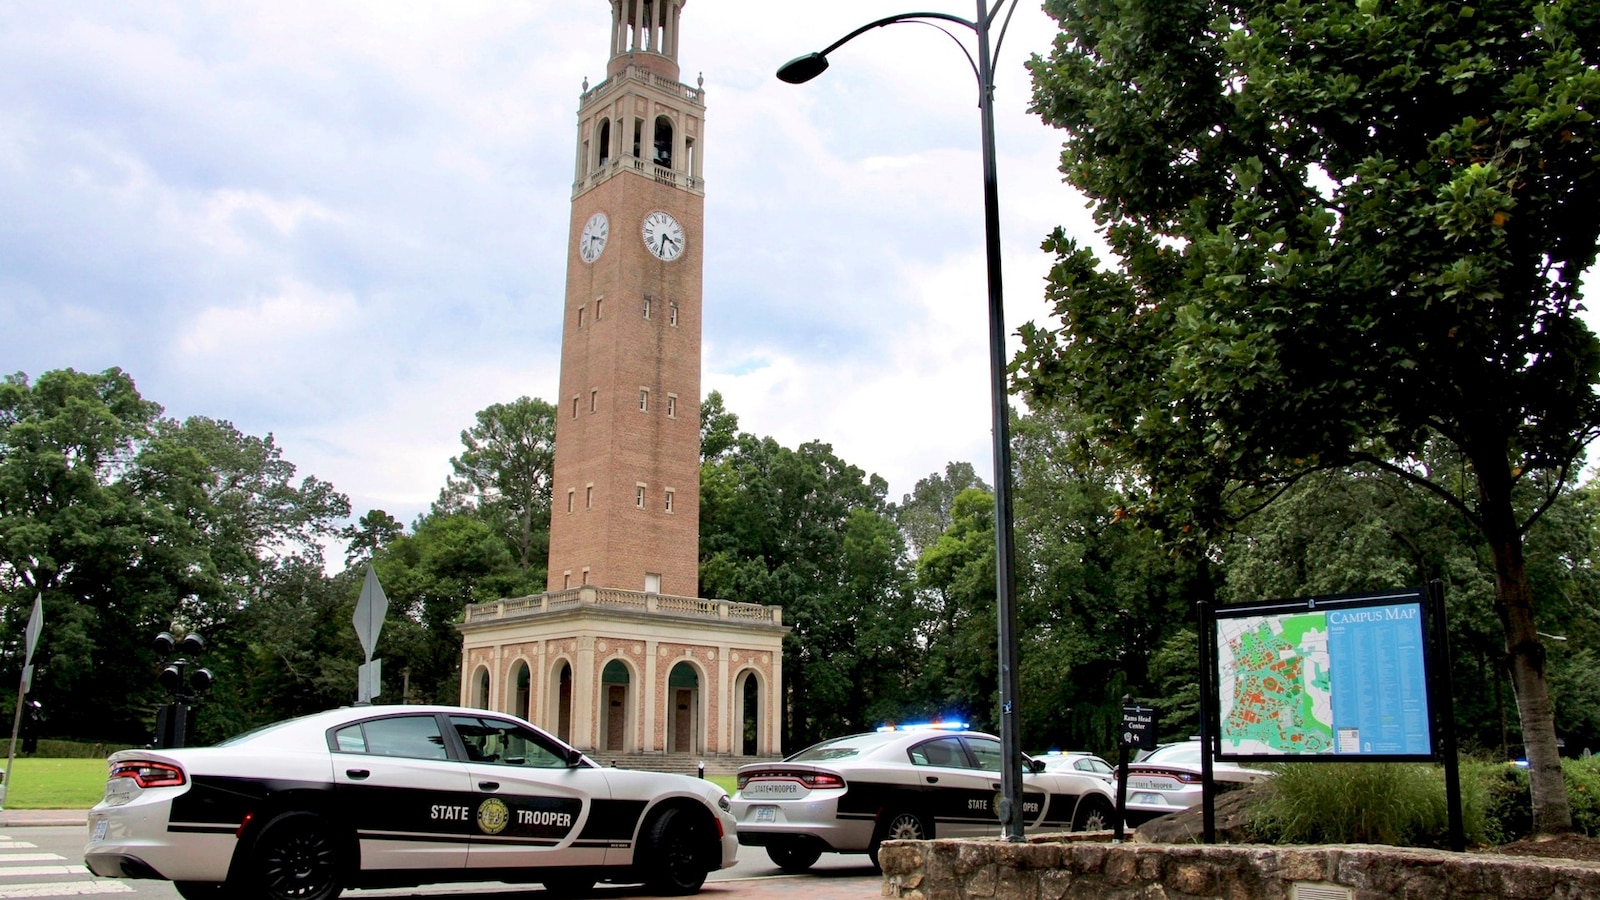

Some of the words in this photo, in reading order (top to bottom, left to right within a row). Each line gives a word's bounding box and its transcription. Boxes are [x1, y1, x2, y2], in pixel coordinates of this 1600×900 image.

[1330, 611, 1383, 624] CAMPUS
[1385, 608, 1416, 621] MAP
[1123, 714, 1138, 722] Rams
[1138, 715, 1152, 723] Head
[754, 785, 770, 793] STATE
[771, 785, 797, 793] TROOPER
[967, 799, 987, 810] STATE
[1023, 802, 1039, 812] OPER
[430, 804, 469, 820] STATE
[517, 810, 571, 827] TROOPER
